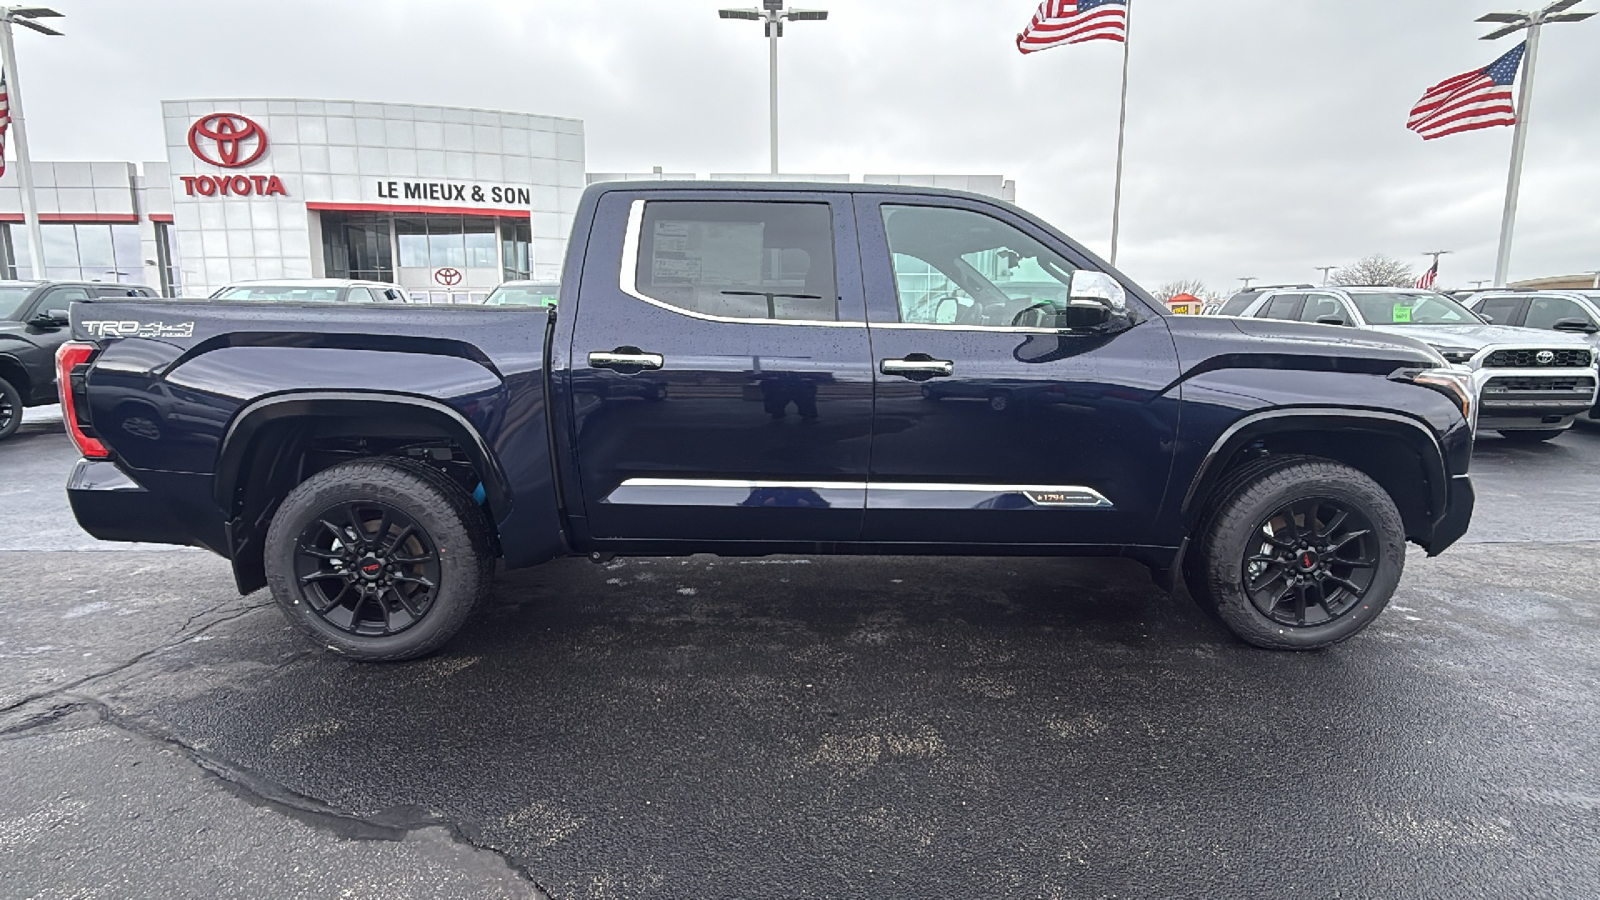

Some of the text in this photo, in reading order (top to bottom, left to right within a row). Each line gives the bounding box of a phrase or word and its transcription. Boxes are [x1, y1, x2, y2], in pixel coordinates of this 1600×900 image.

[179, 175, 286, 196] TOYOTA
[377, 181, 531, 205] LE MIEUX & SON
[81, 321, 140, 338] TRD
